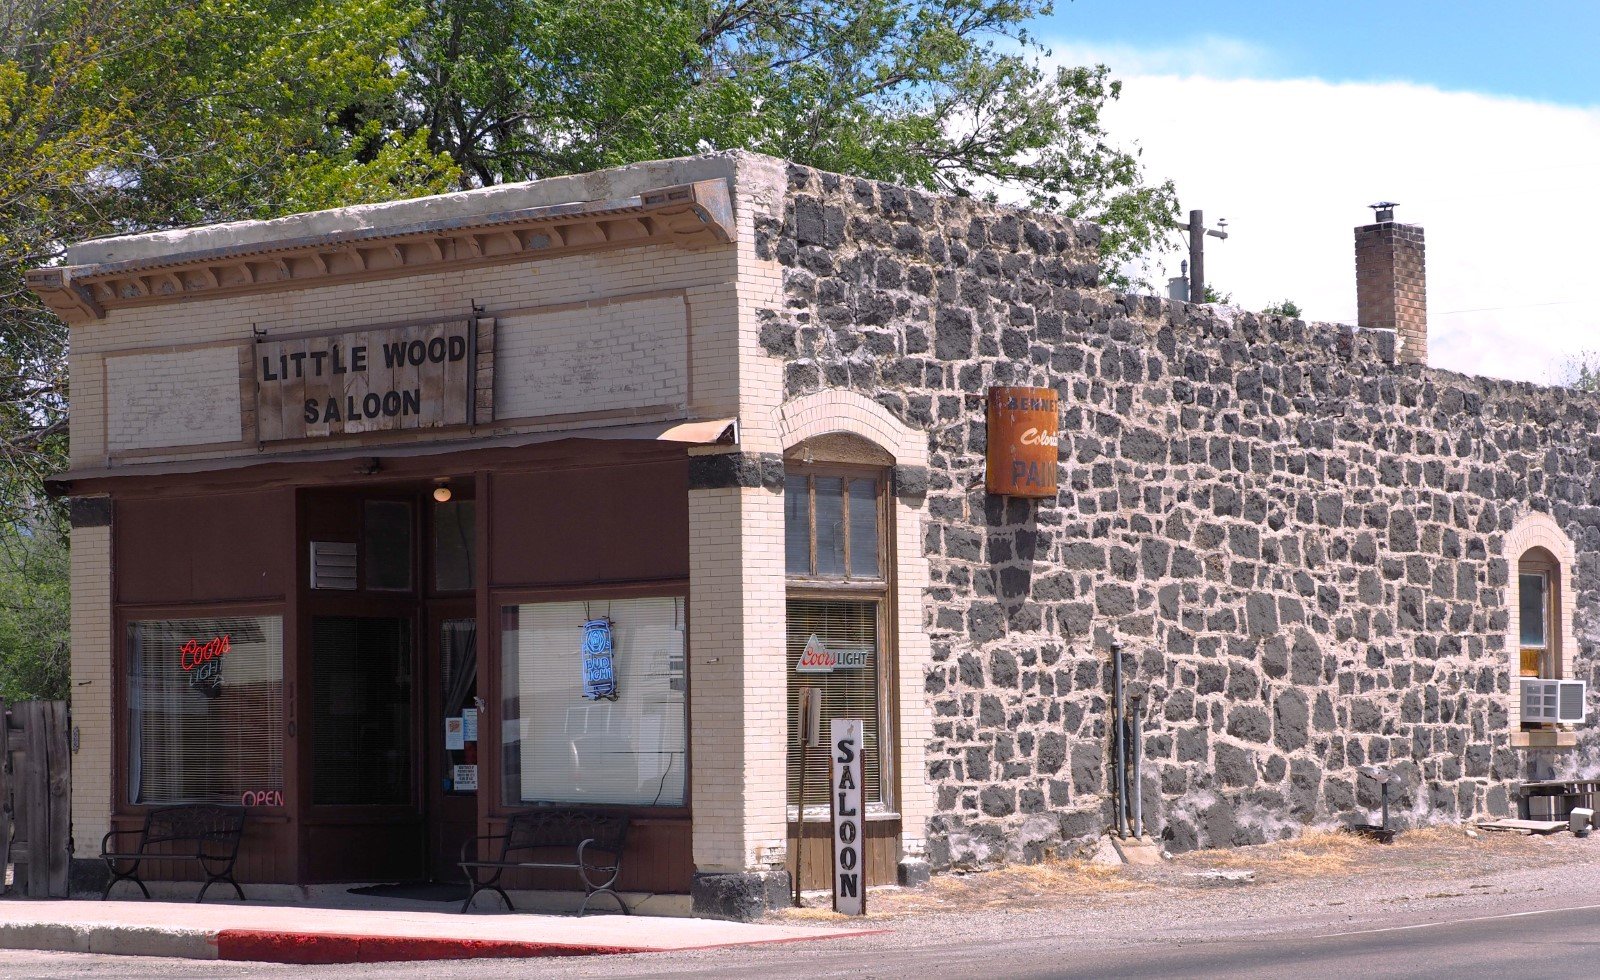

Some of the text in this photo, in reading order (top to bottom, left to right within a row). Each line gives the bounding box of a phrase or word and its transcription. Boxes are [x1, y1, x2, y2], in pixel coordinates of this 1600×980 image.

[262, 335, 466, 381] LITTLE WOOD
[303, 388, 421, 425] SALOON
[180, 633, 232, 671] Coors
[586, 657, 609, 670] BUD
[801, 645, 836, 667] Coors
[837, 650, 868, 667] LIGHT
[189, 656, 225, 687] LIGHT
[241, 790, 284, 807] OPEN
[837, 739, 858, 898] SALOON
